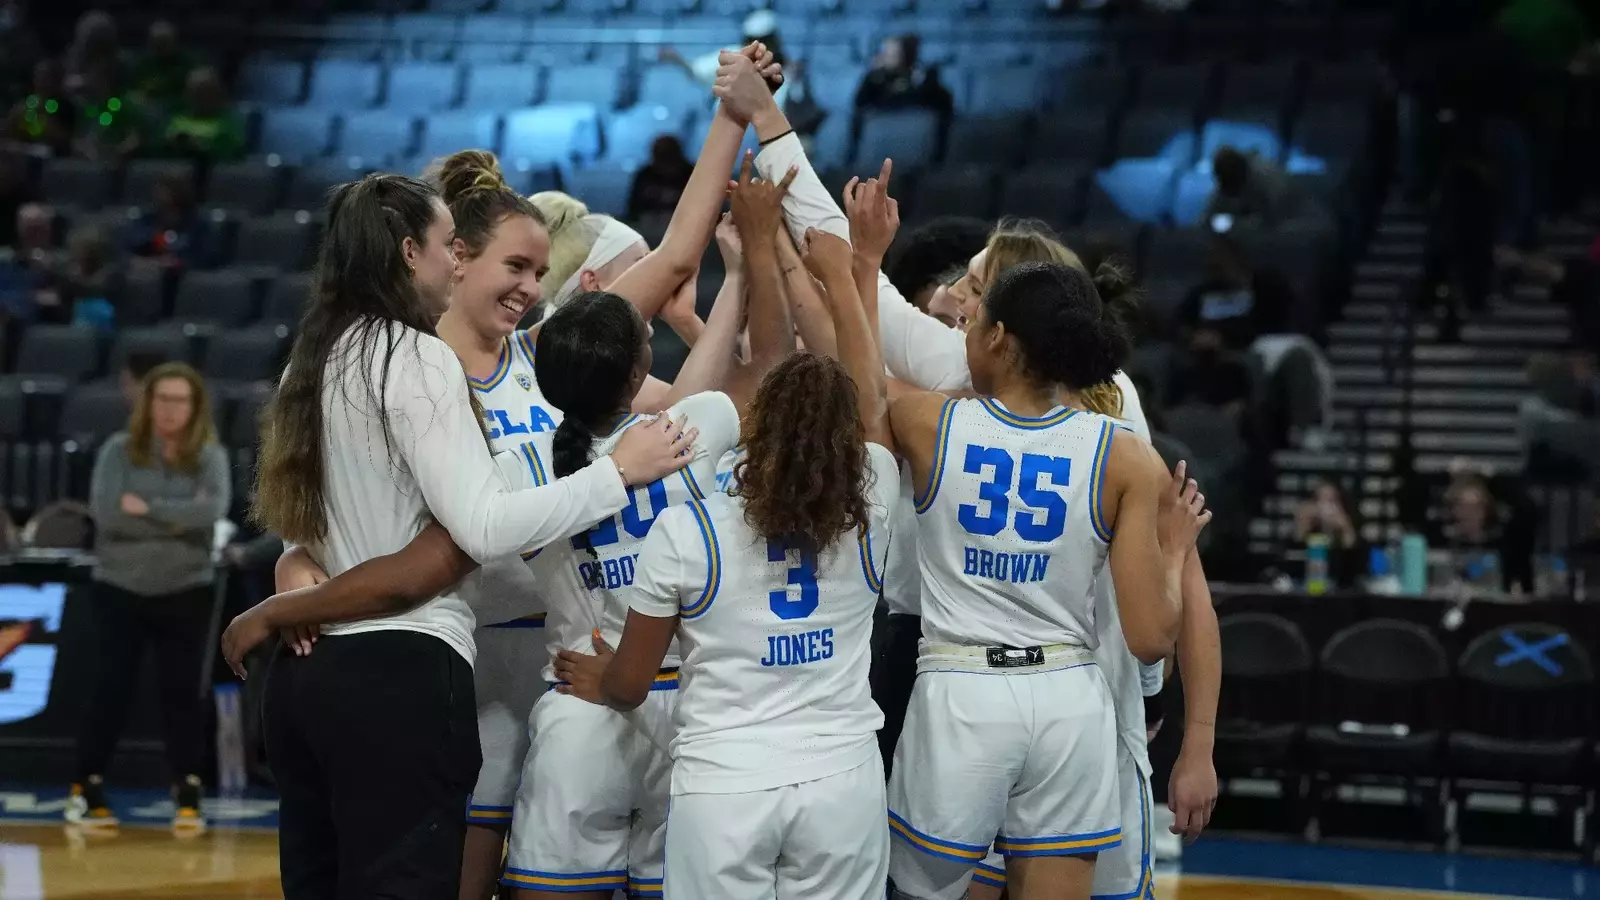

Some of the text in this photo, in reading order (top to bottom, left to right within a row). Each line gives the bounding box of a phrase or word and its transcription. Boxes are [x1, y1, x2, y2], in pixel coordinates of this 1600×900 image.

[957, 443, 1071, 543] 35
[766, 533, 820, 620] 3
[963, 546, 1050, 583] BROWN
[761, 627, 834, 667] JONES
